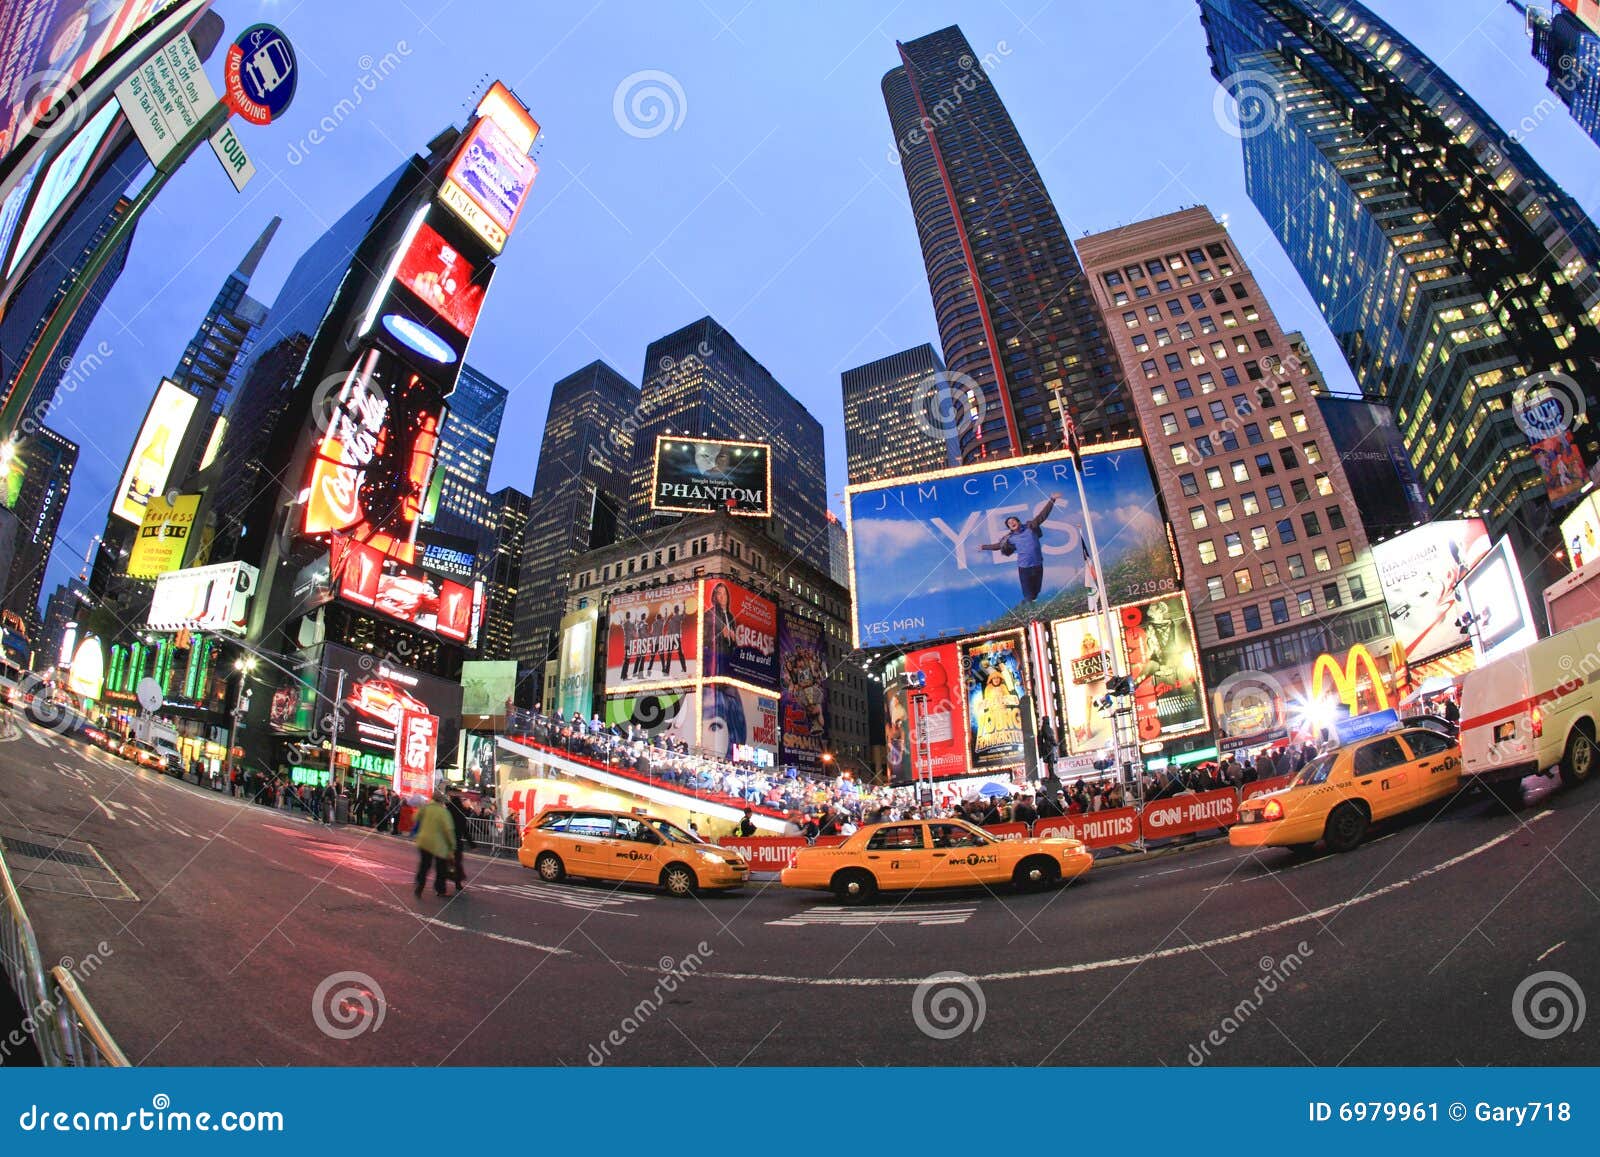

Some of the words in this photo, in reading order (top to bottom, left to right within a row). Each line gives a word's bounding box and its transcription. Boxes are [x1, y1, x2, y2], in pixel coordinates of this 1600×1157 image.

[179, 36, 190, 57] Pick
[155, 55, 167, 68] NY
[230, 53, 241, 70] NO
[160, 67, 170, 80] Air
[168, 45, 182, 67] Drop
[179, 67, 190, 82] Off
[186, 82, 200, 104] Only
[166, 79, 178, 97] Port
[231, 75, 267, 120] STANDING
[130, 76, 142, 96] Big
[139, 91, 153, 114] Taxi
[149, 112, 166, 140] Tours
[163, 101, 174, 115] NY
[220, 128, 247, 173] TOUR
[660, 482, 763, 503] PHANTOM
[876, 485, 938, 511] JIM
[963, 455, 1122, 496] CARREY
[32, 488, 54, 544] NOVOTEL
[143, 526, 188, 538] MUSIC
[930, 499, 1079, 570] YES
[423, 556, 440, 564] NEW
[444, 561, 472, 572] SERIES
[425, 544, 475, 566] LEVERAGE
[613, 594, 642, 605] BEST
[645, 583, 699, 600] MUSICAL
[1128, 578, 1175, 596] 12.19.08
[864, 621, 890, 635] YES
[893, 616, 925, 630] MAN
[627, 635, 657, 656] JERSEY
[658, 633, 680, 653] BOYS
[735, 624, 775, 656] GREASE
[407, 717, 433, 769] tkts
[1149, 807, 1182, 827] CNN
[1189, 798, 1233, 822] POLITICS
[1084, 819, 1133, 839] POLITICS
[967, 854, 997, 865] TAXI
